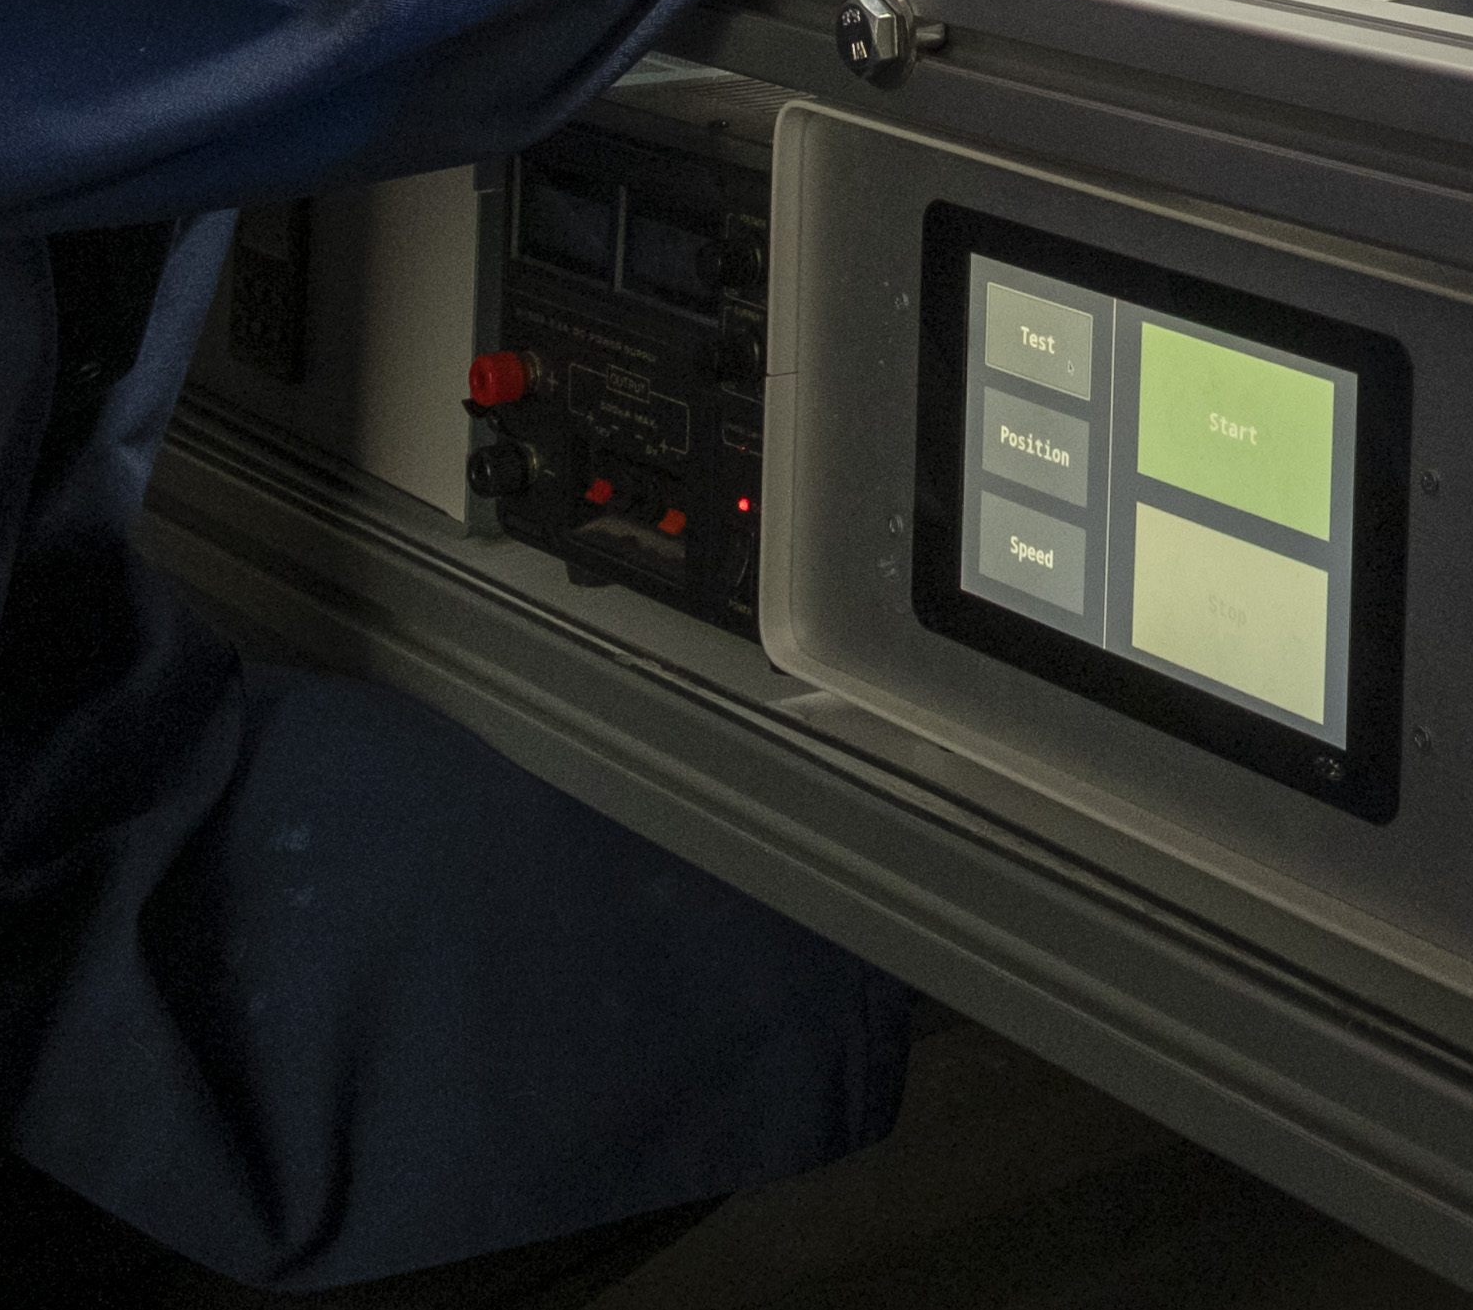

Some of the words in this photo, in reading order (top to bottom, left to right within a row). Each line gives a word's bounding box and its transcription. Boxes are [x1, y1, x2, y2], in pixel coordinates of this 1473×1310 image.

[1020, 325, 1055, 354] Test
[609, 372, 646, 394] OUTPUT
[1209, 412, 1258, 445] Start
[1000, 425, 1070, 468] Position
[1010, 536, 1054, 569] Speed
[1208, 594, 1248, 627] Stop
